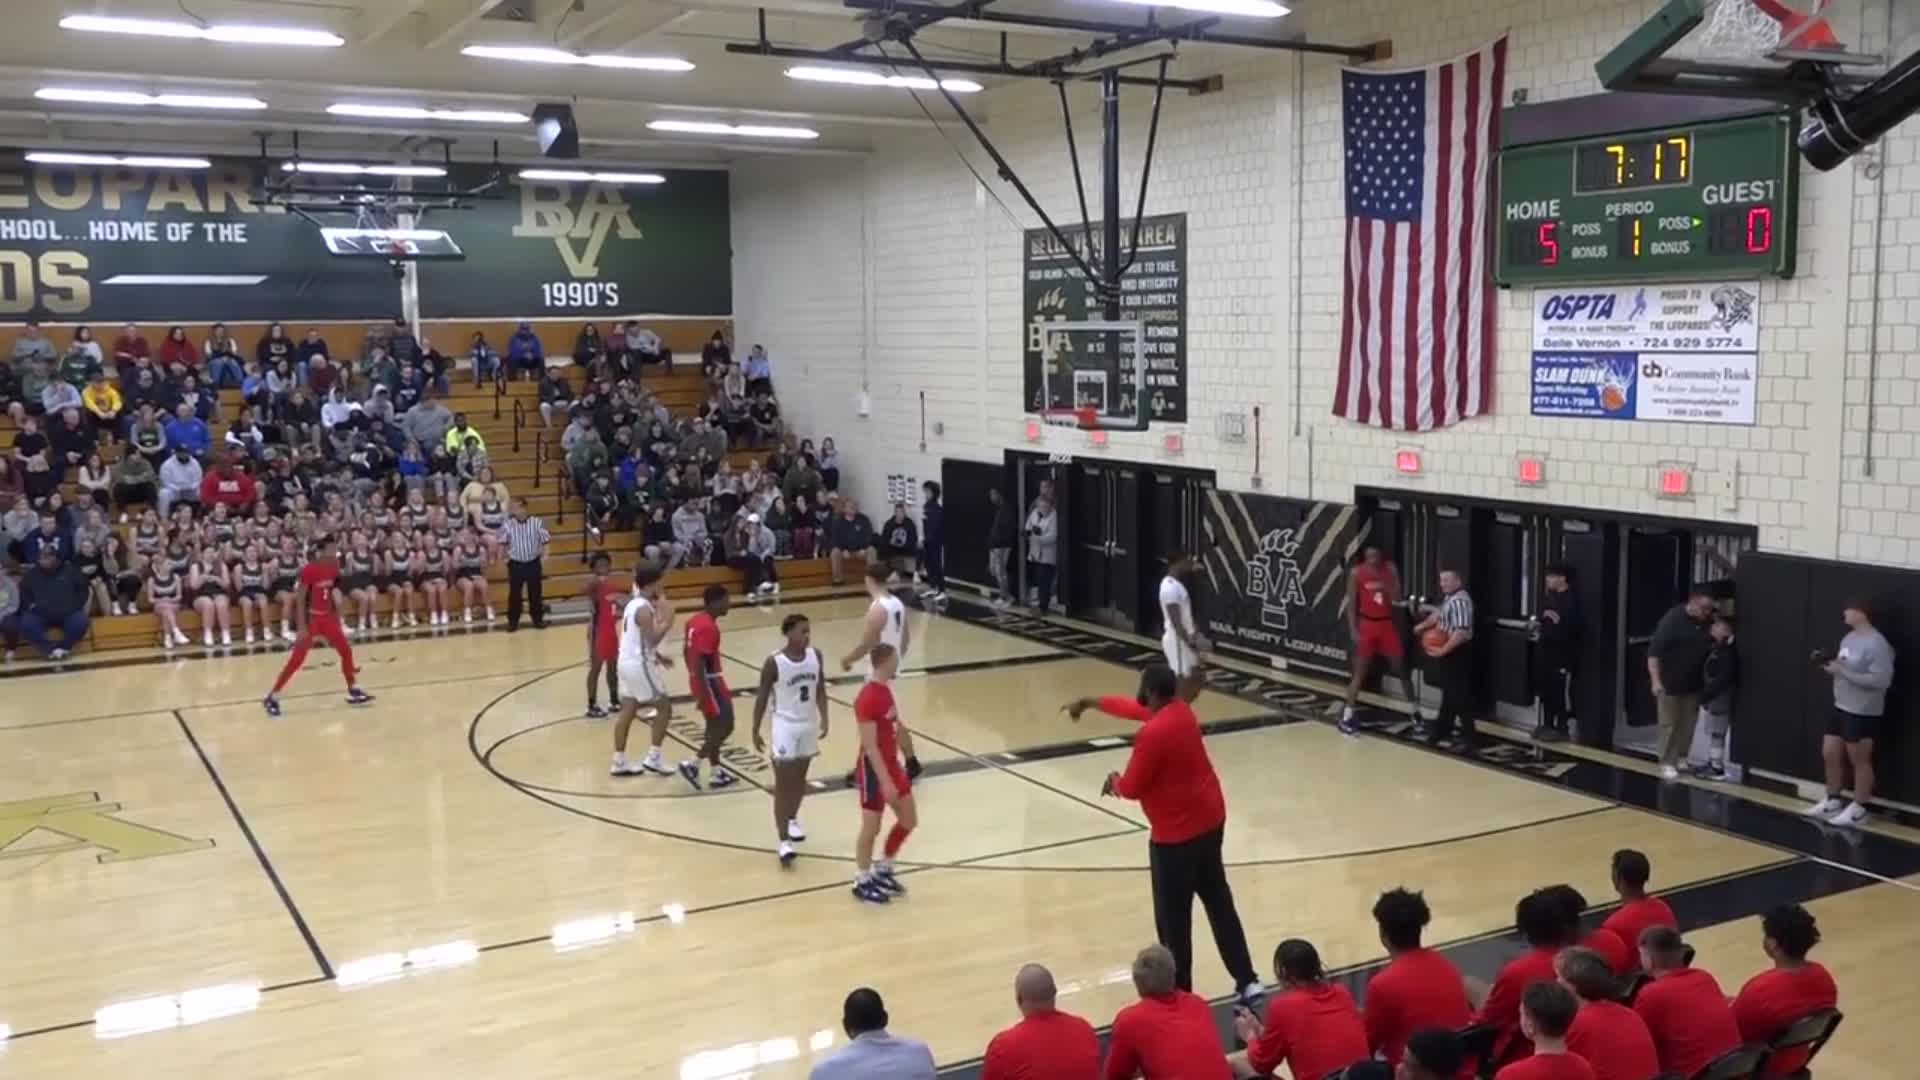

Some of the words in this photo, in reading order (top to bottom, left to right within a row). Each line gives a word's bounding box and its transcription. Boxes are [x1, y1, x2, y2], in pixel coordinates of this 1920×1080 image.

[1606, 135, 1687, 185] 7:17
[1702, 179, 1776, 205] GUEST
[1506, 199, 1561, 220] HOME
[1604, 200, 1655, 217] PERIOD
[166, 222, 194, 242] OF
[203, 222, 248, 243] THE
[1572, 222, 1601, 236] POSS
[1659, 216, 1691, 230] POSS
[1745, 206, 1772, 256] 0
[1537, 220, 1559, 266] 5
[1633, 219, 1640, 257] 1
[1650, 240, 1691, 255] BONUS
[1571, 245, 1608, 259] BONUS
[542, 281, 620, 307] 1990'S
[1542, 294, 1616, 320] OSPTA
[1543, 338, 1573, 348] Belle
[1576, 338, 1622, 348] Vernon
[1643, 337, 1669, 348] 724
[1673, 337, 1701, 348] 929
[1705, 337, 1743, 348] 5774
[1535, 367, 1569, 384] SLAM
[1570, 366, 1606, 386] DUNK
[1664, 367, 1722, 384] Community
[1723, 367, 1752, 381] Bank
[1246, 554, 1307, 611] BVA
[1283, 635, 1349, 661] LEOPARDS
[799, 685, 810, 703] 2
